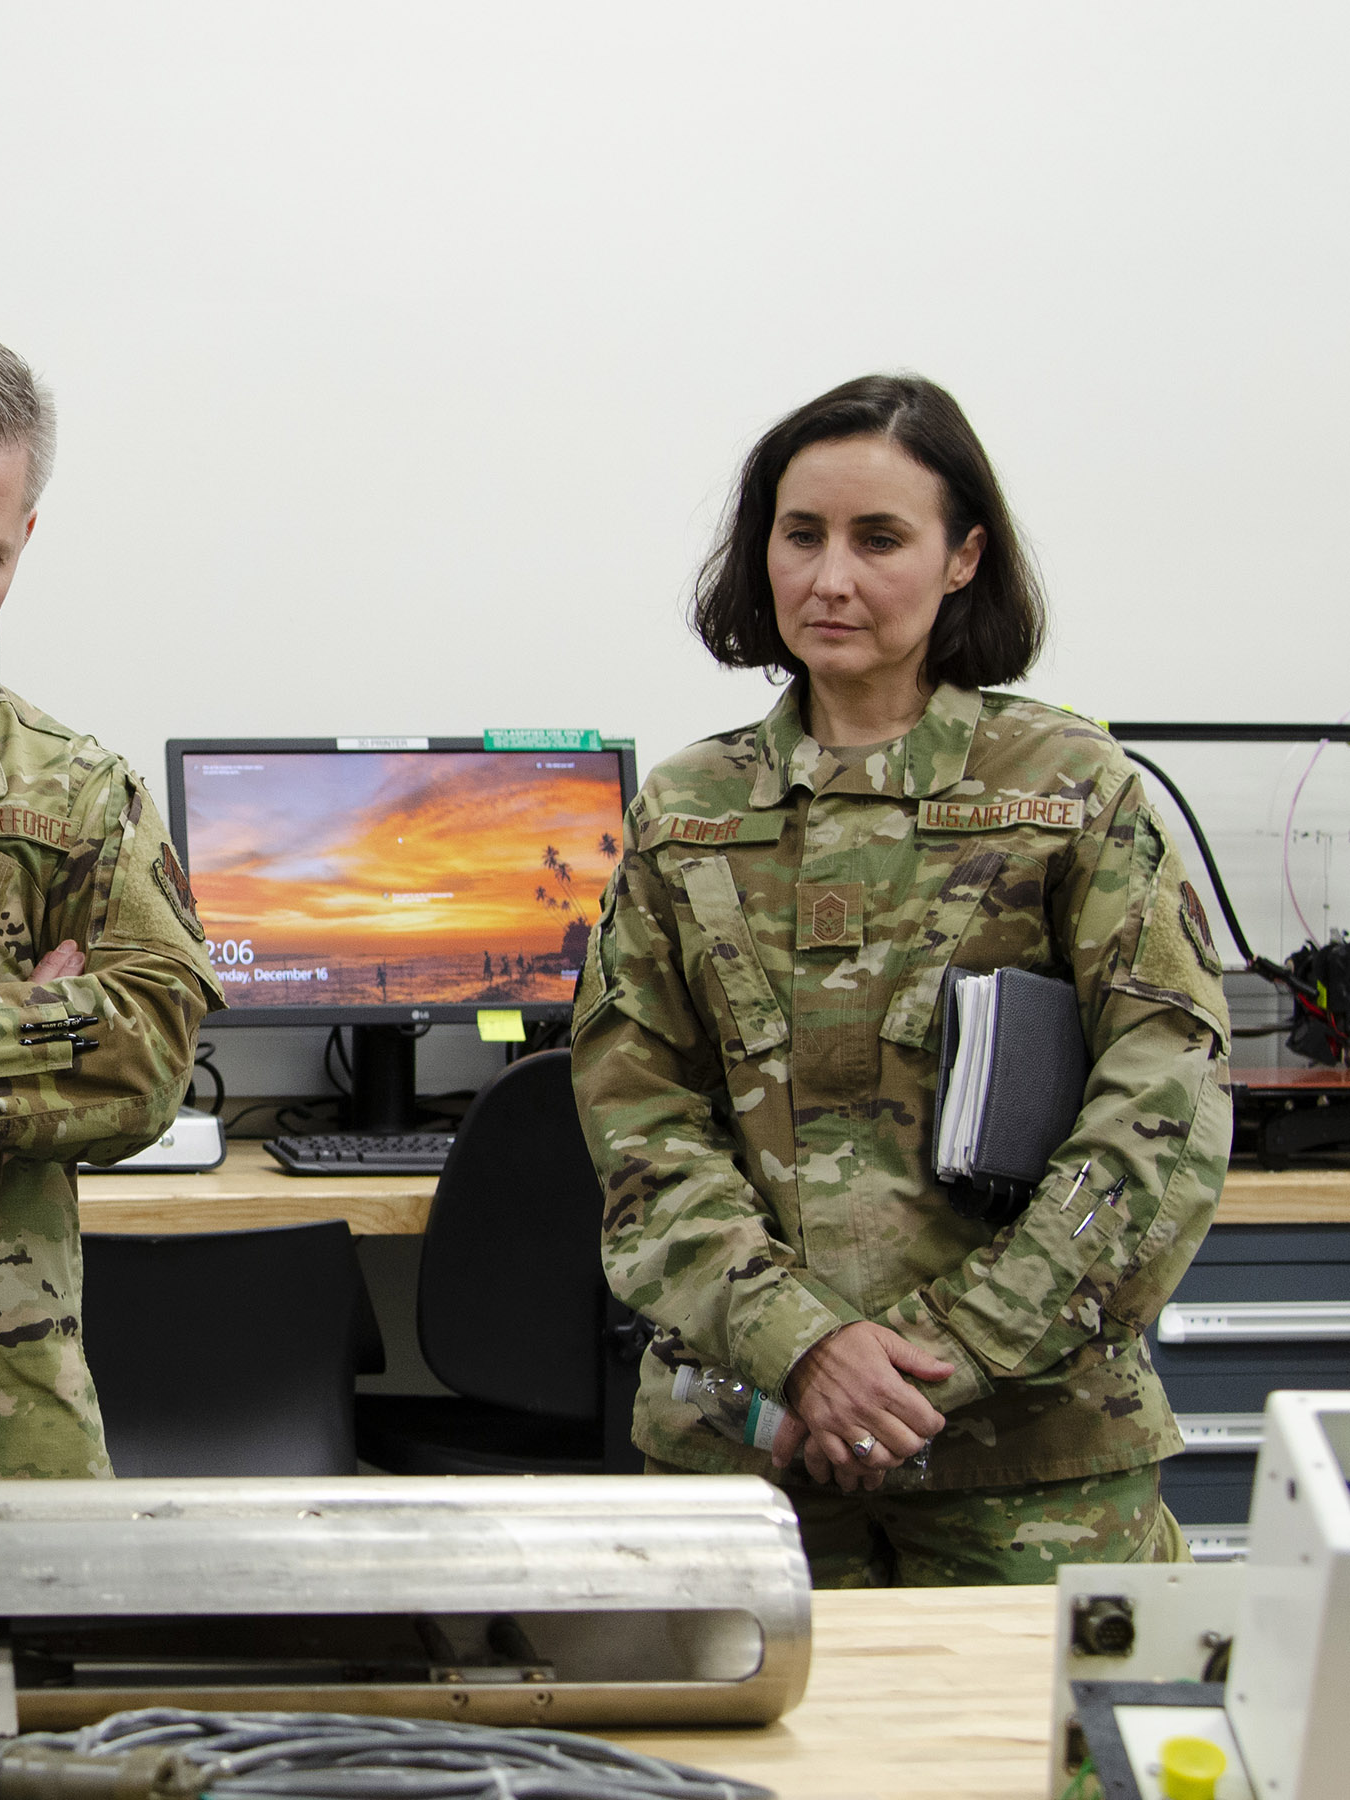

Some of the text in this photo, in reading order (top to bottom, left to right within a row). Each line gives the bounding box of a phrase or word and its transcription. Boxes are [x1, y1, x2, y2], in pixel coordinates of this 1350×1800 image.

[926, 799, 1075, 828] U.S. AIR FORCE
[12, 807, 72, 848] FORCE
[669, 817, 743, 841] LEIFER
[253, 968, 312, 981] December
[314, 966, 329, 981] 16
